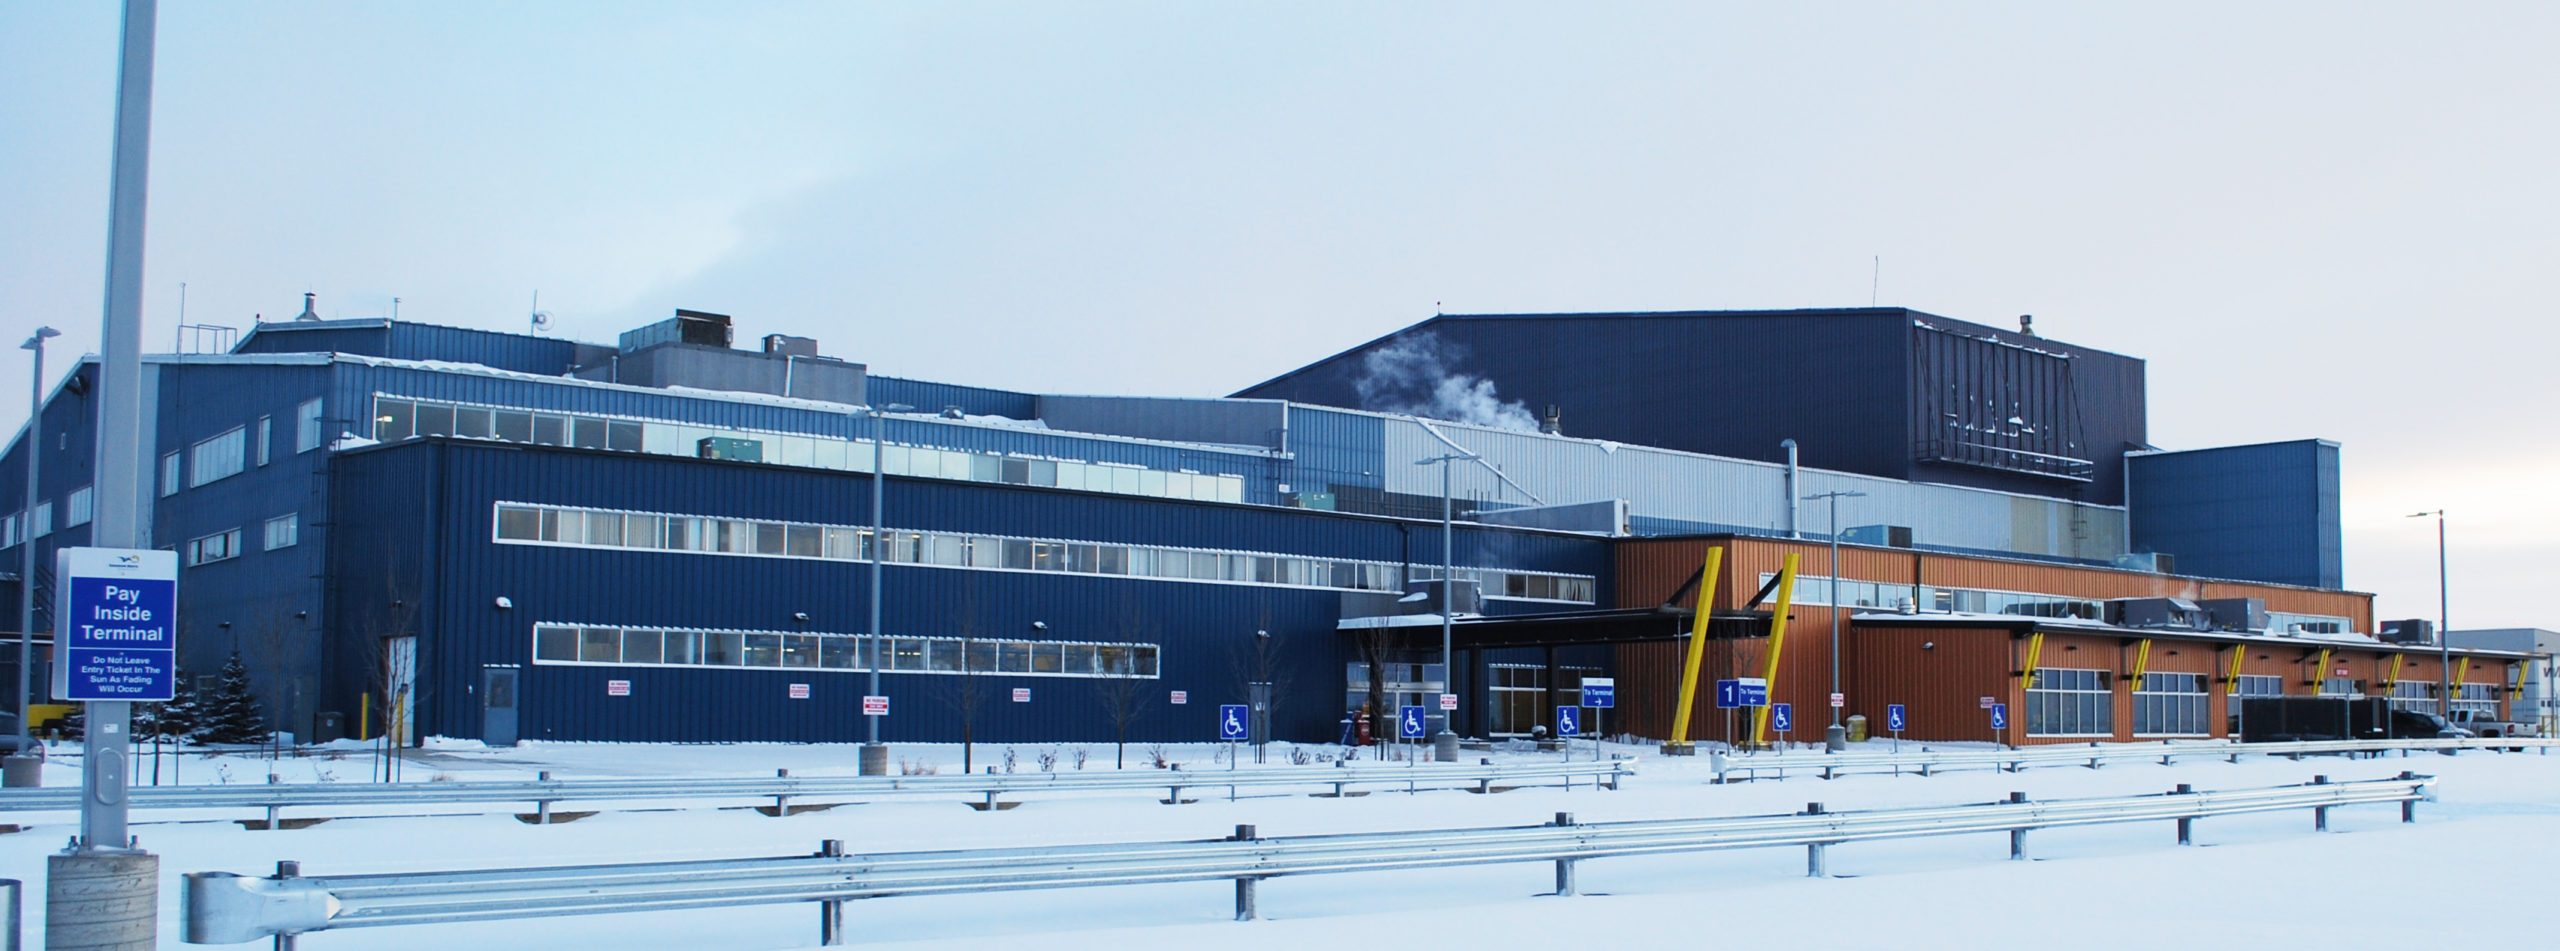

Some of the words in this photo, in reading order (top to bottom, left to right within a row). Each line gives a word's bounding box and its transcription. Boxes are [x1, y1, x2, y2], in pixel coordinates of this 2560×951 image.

[105, 585, 140, 605] Pay
[94, 605, 152, 621] Inside
[81, 624, 163, 641] Terminal
[92, 656, 106, 664] Do
[107, 656, 123, 665] Not
[125, 657, 151, 665] Leave
[81, 666, 105, 675] Entry
[106, 666, 133, 674] Ticket
[145, 666, 161, 674] The
[90, 675, 108, 683] Sun
[123, 676, 153, 685] Fading
[99, 685, 115, 693] Will
[117, 685, 143, 693] Occur
[1584, 688, 1592, 696] To
[1740, 687, 1747, 695] To
[1747, 688, 1766, 696] Terminal
[1725, 685, 1733, 703] 1
